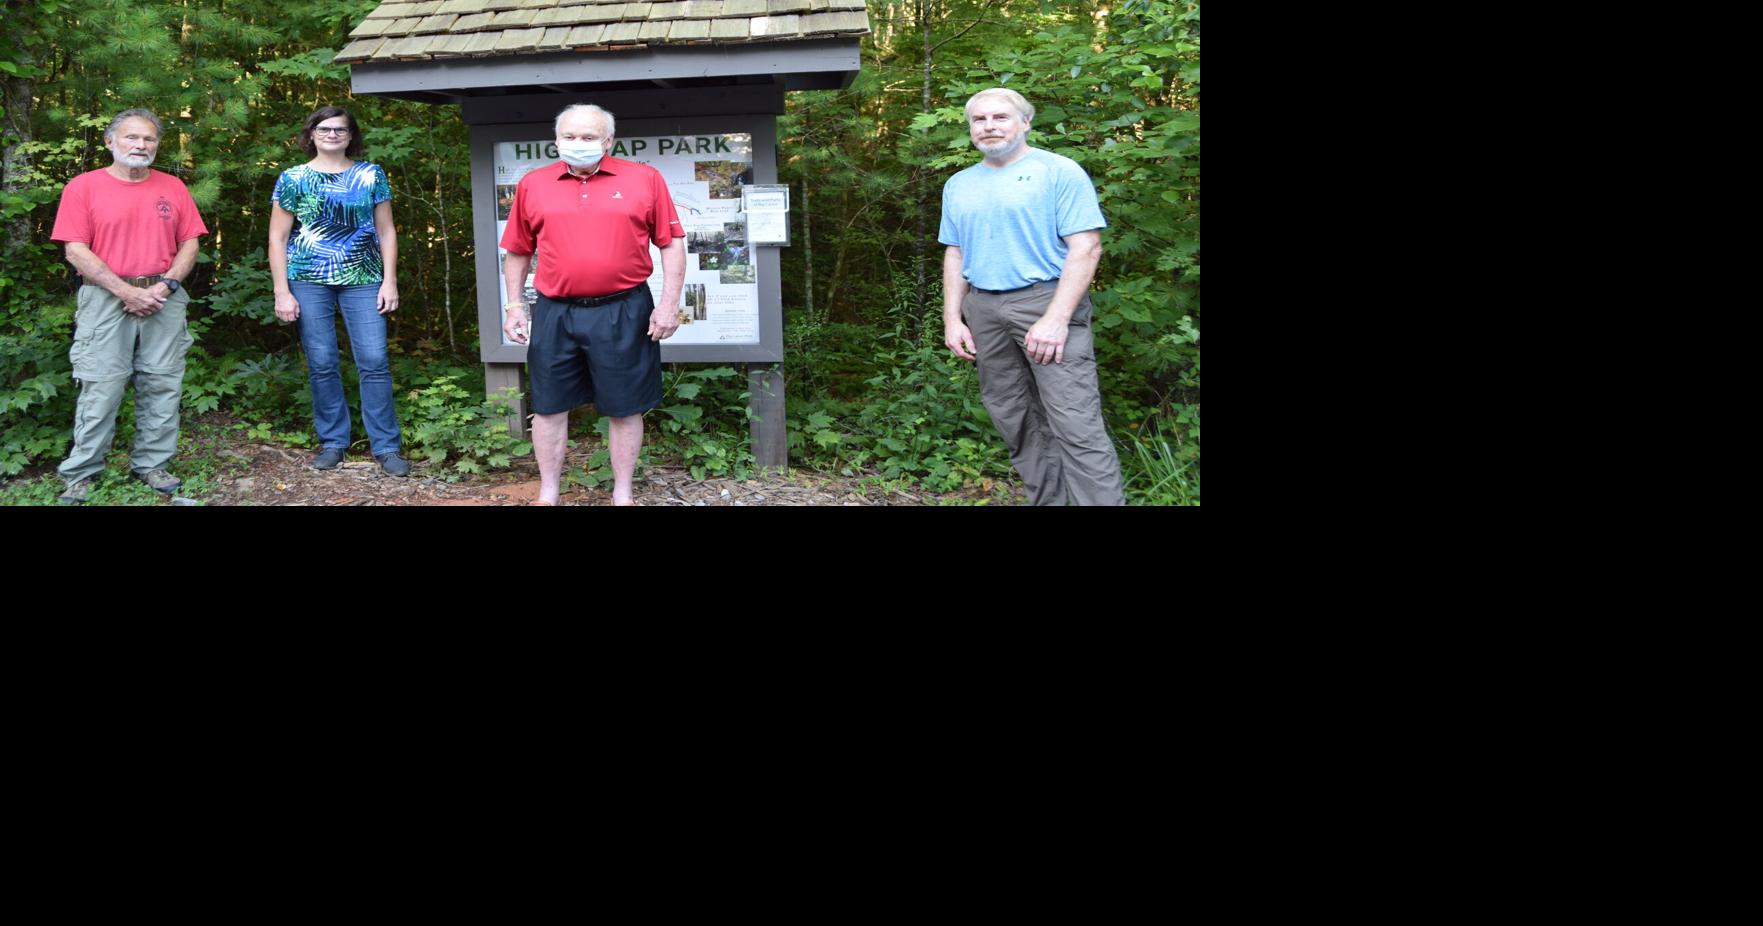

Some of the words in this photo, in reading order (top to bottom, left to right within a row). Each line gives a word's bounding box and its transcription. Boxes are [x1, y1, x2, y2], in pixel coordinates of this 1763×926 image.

[515, 143, 560, 160] HIG
[610, 140, 647, 157] AP
[658, 136, 731, 156] PARK
